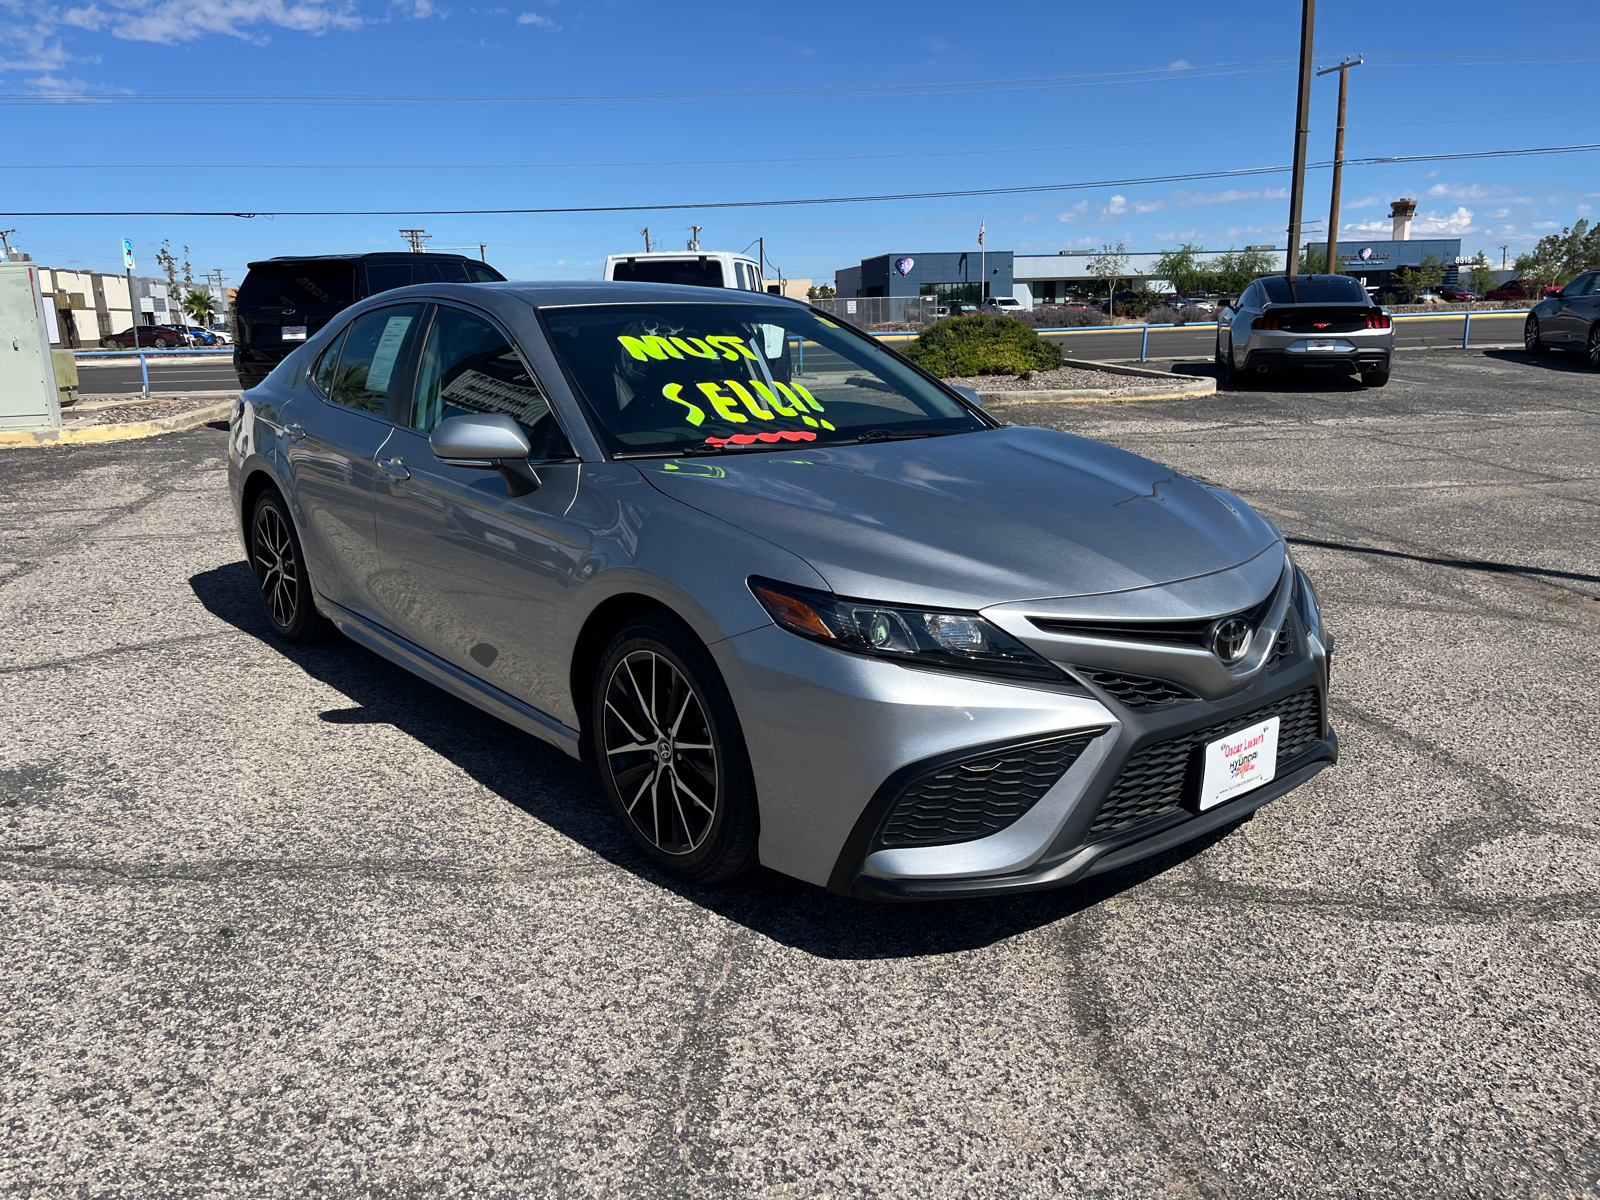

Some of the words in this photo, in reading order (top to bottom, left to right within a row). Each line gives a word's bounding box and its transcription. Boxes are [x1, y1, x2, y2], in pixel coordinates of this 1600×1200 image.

[1455, 256, 1472, 264] 8515
[617, 335, 759, 361] MUST
[662, 380, 836, 431] SELL!!
[1224, 743, 1243, 758] Oscar
